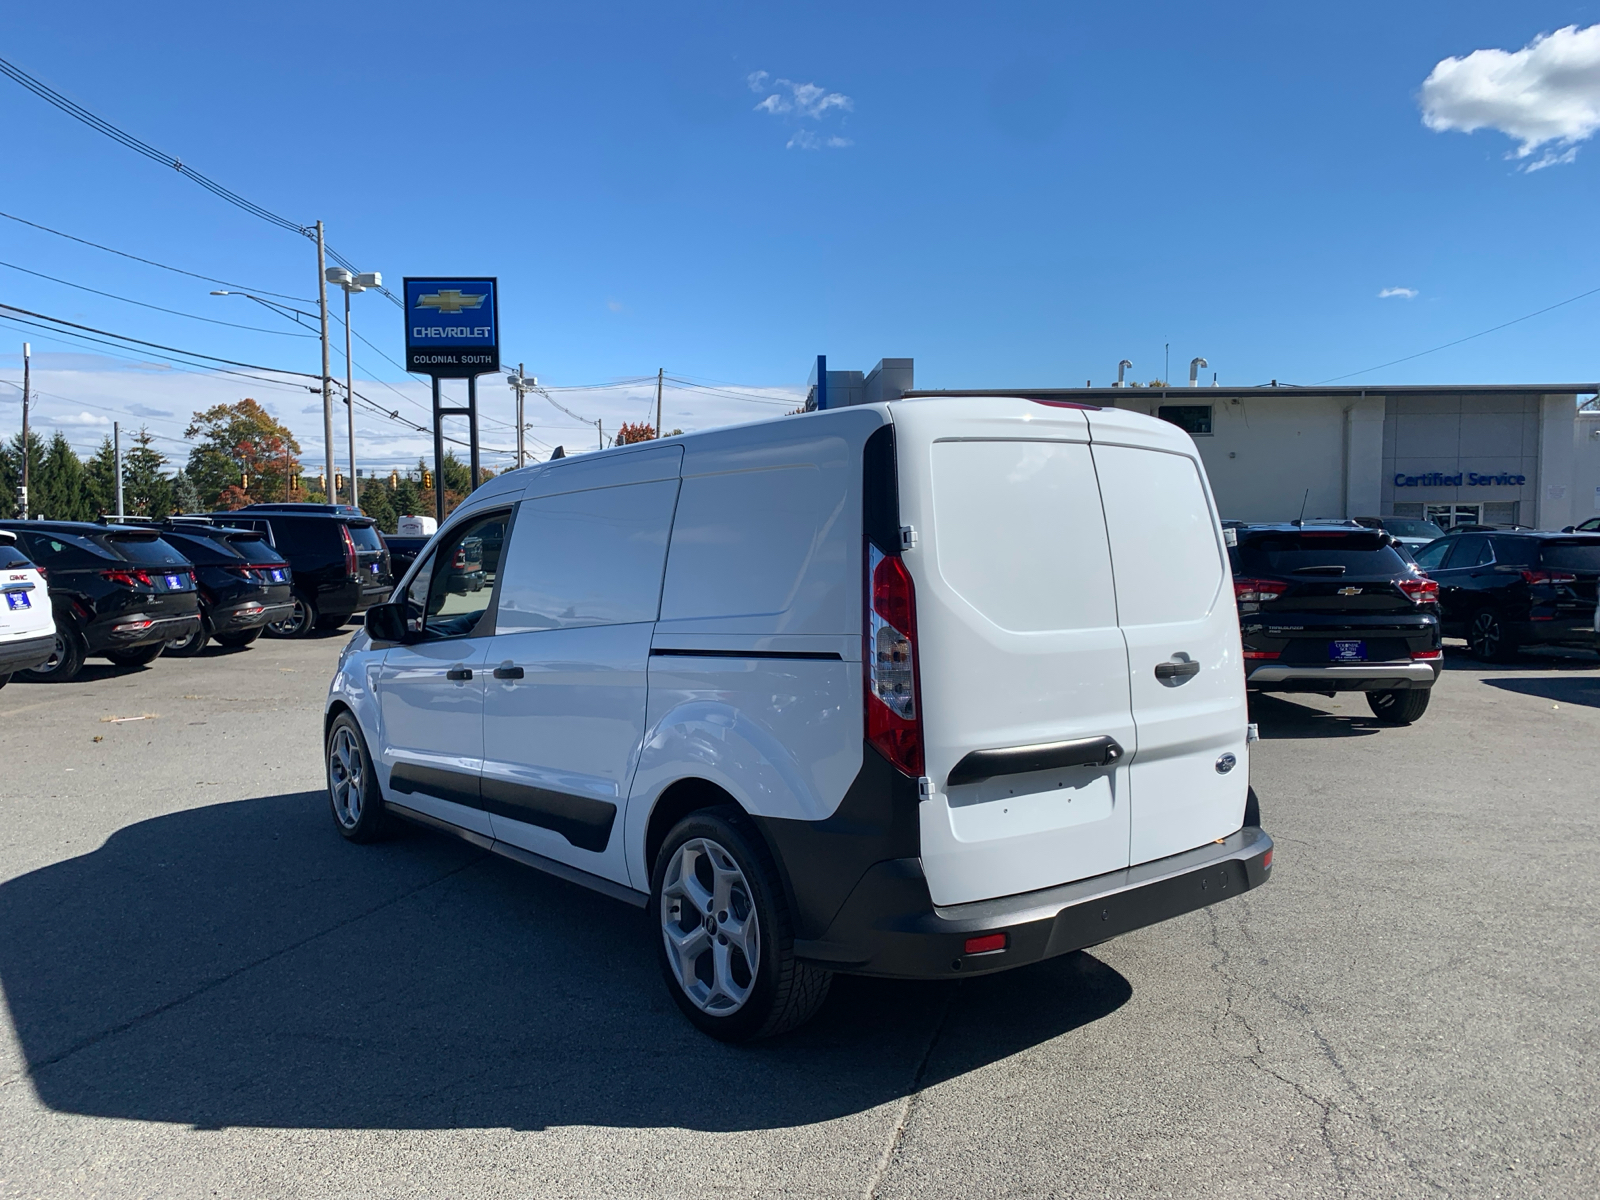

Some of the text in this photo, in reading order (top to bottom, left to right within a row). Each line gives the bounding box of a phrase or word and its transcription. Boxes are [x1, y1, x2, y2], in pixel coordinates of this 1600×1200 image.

[413, 326, 491, 338] CHEVROLET
[413, 355, 492, 364] COLONIAL SOUTH
[1394, 472, 1526, 488] Certified Service
